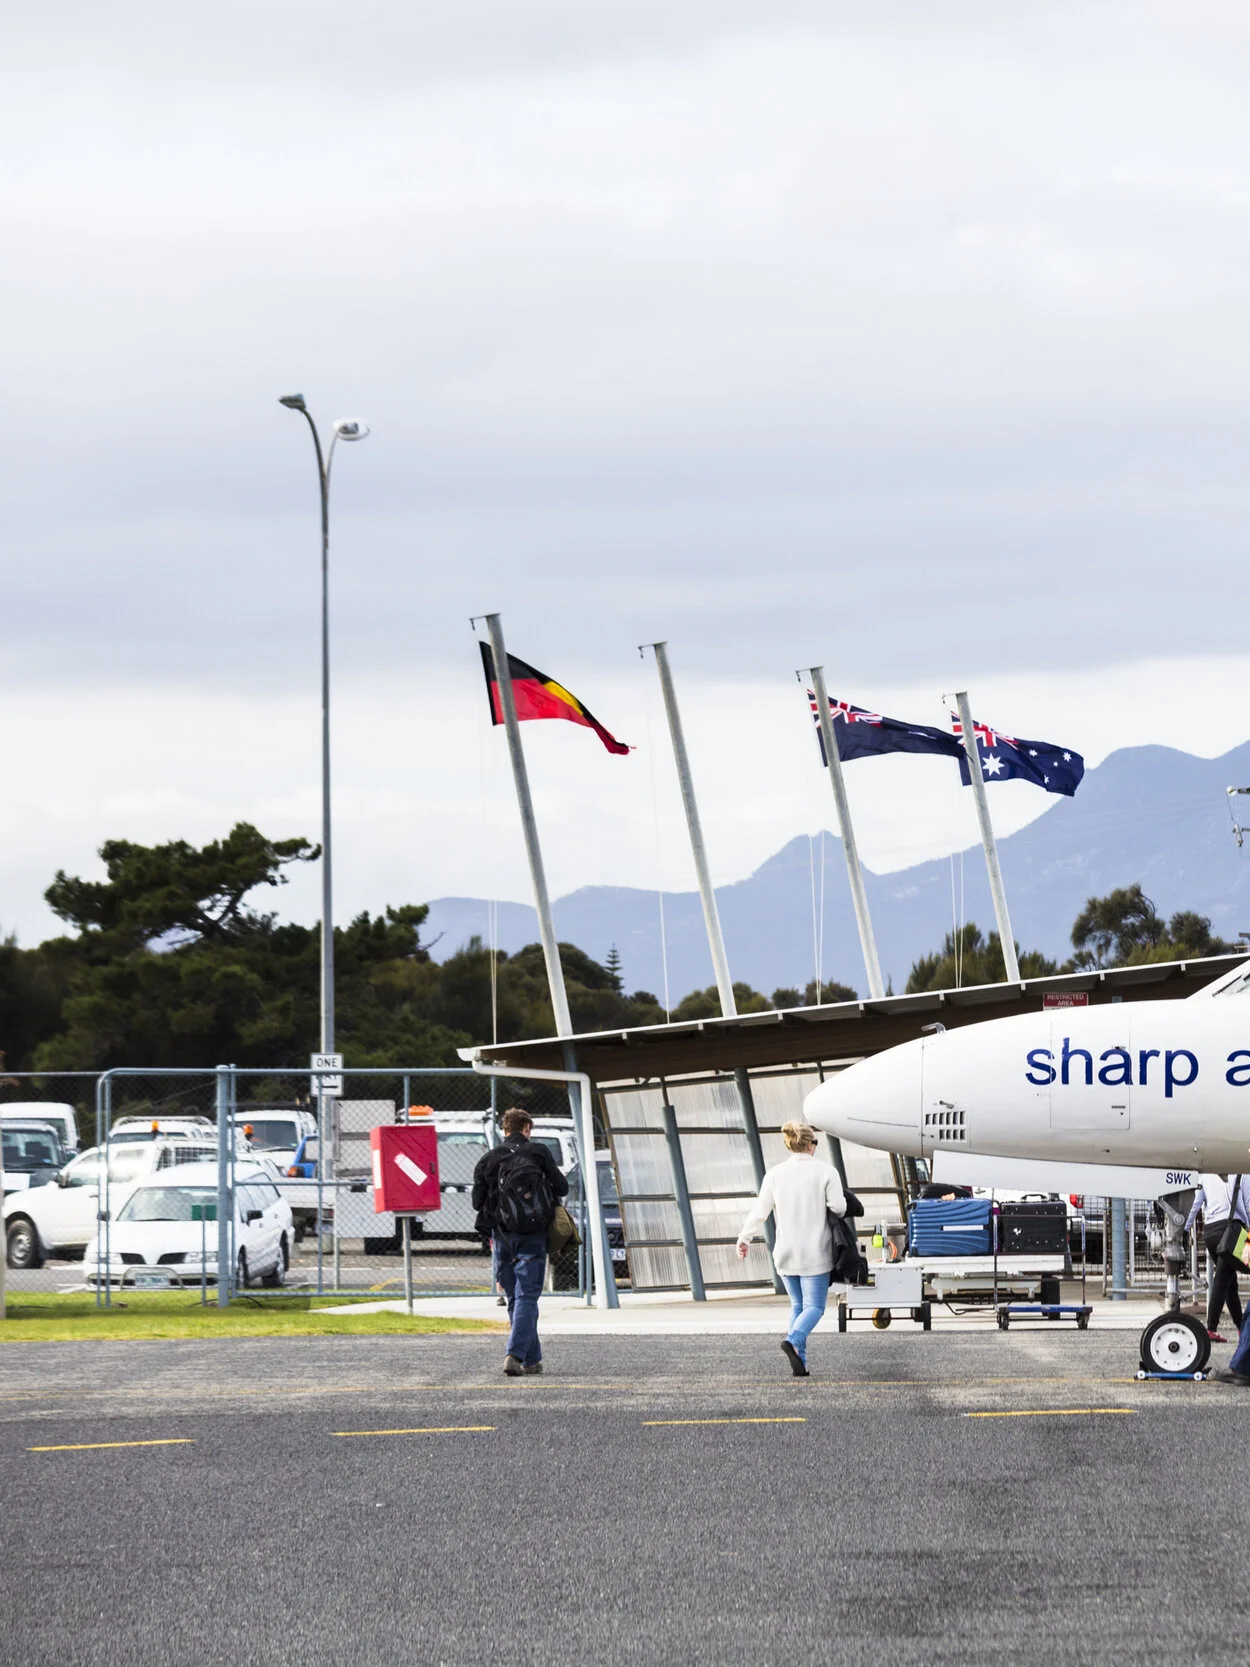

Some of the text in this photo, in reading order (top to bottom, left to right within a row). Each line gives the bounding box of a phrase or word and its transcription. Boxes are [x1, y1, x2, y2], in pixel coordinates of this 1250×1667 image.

[316, 1057, 338, 1068] ONE
[1025, 1037, 1199, 1098] sharp
[1165, 1172, 1192, 1185] SWK
